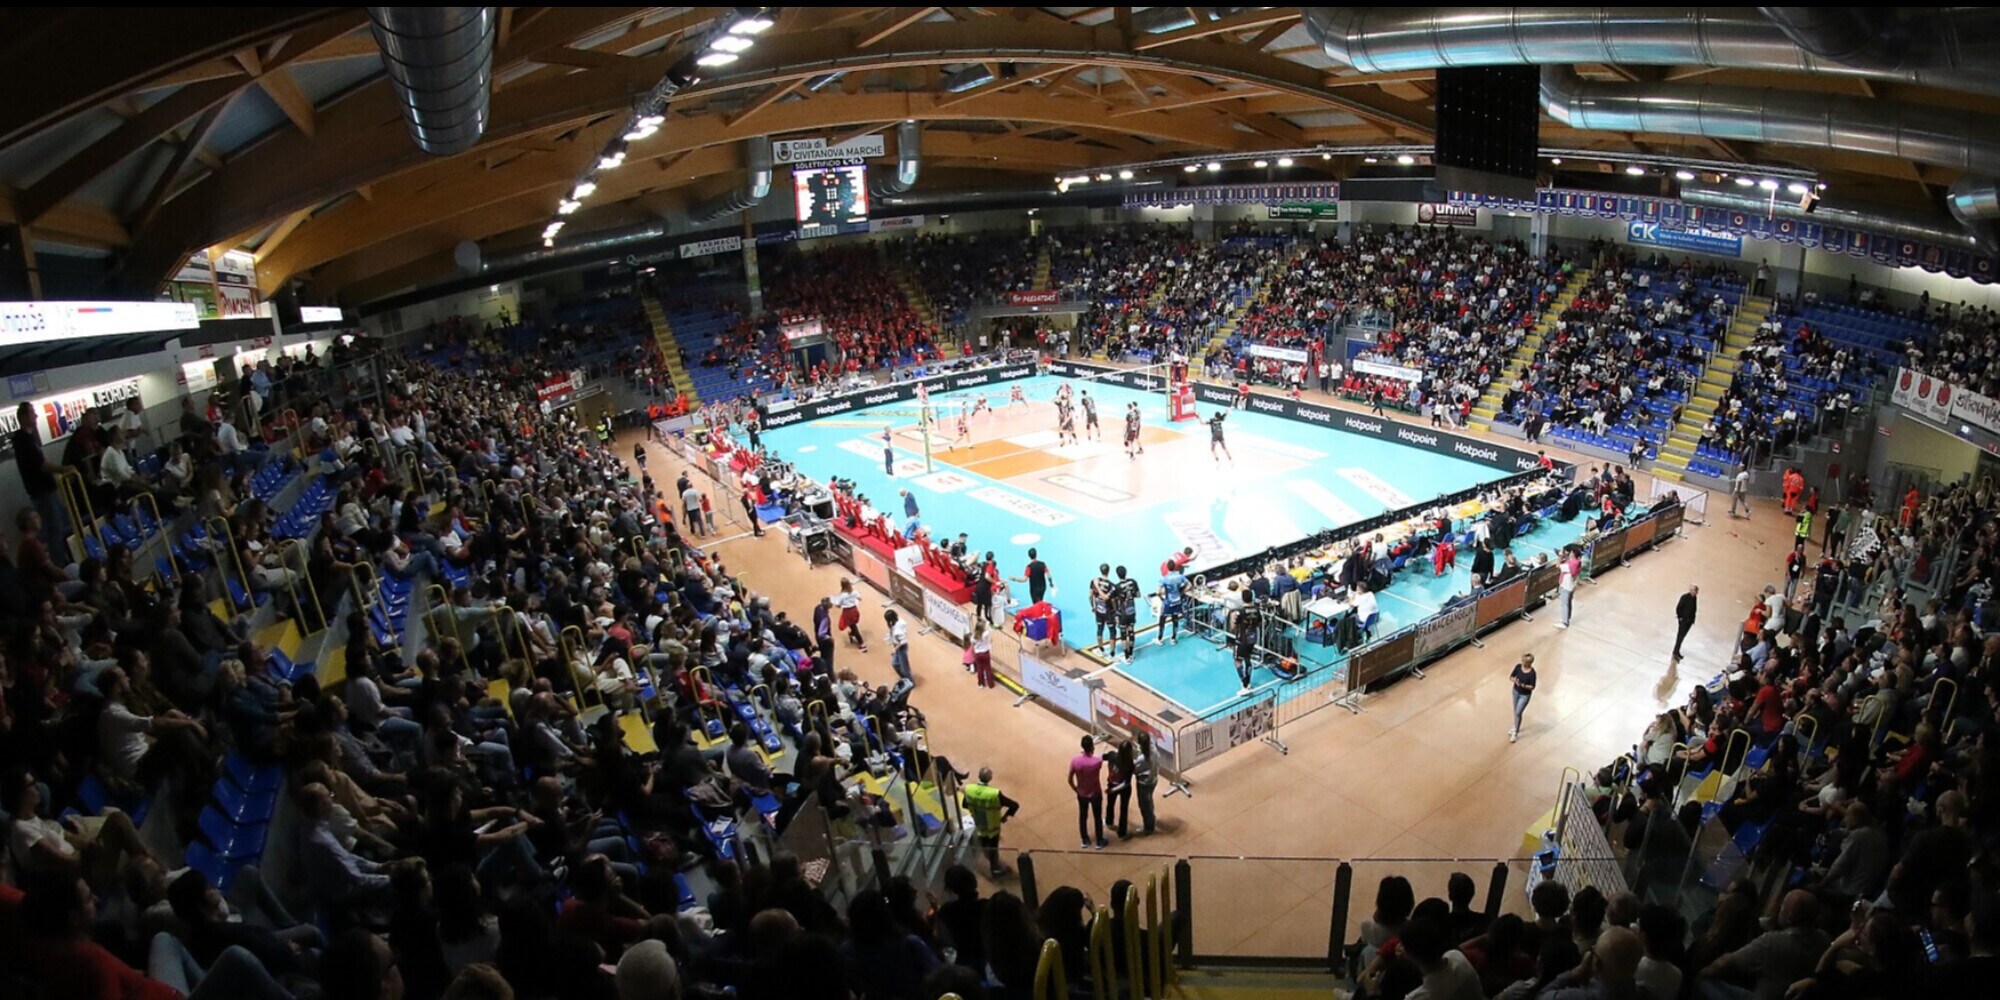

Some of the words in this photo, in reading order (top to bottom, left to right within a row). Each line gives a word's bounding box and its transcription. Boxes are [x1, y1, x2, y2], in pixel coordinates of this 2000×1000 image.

[792, 140, 812, 151] Città
[815, 140, 823, 149] di
[793, 148, 844, 160] CIVITANOVA
[845, 145, 883, 156] MARCHE
[1000, 368, 1029, 379] Hotpoint
[957, 375, 988, 387] Hotpoint
[865, 391, 899, 404] Hotpoint
[1203, 389, 1231, 403] Hotpoint
[817, 401, 851, 415] Hotpoint
[1252, 398, 1284, 412] Hotpoint
[766, 411, 802, 426] Hotpoint
[1297, 408, 1330, 422] Hotpoint
[1345, 417, 1382, 433] Hotpoint
[1398, 429, 1438, 446] Hotpoint
[1454, 442, 1498, 461] Hotpoint
[1195, 727, 1214, 752] RIPA
